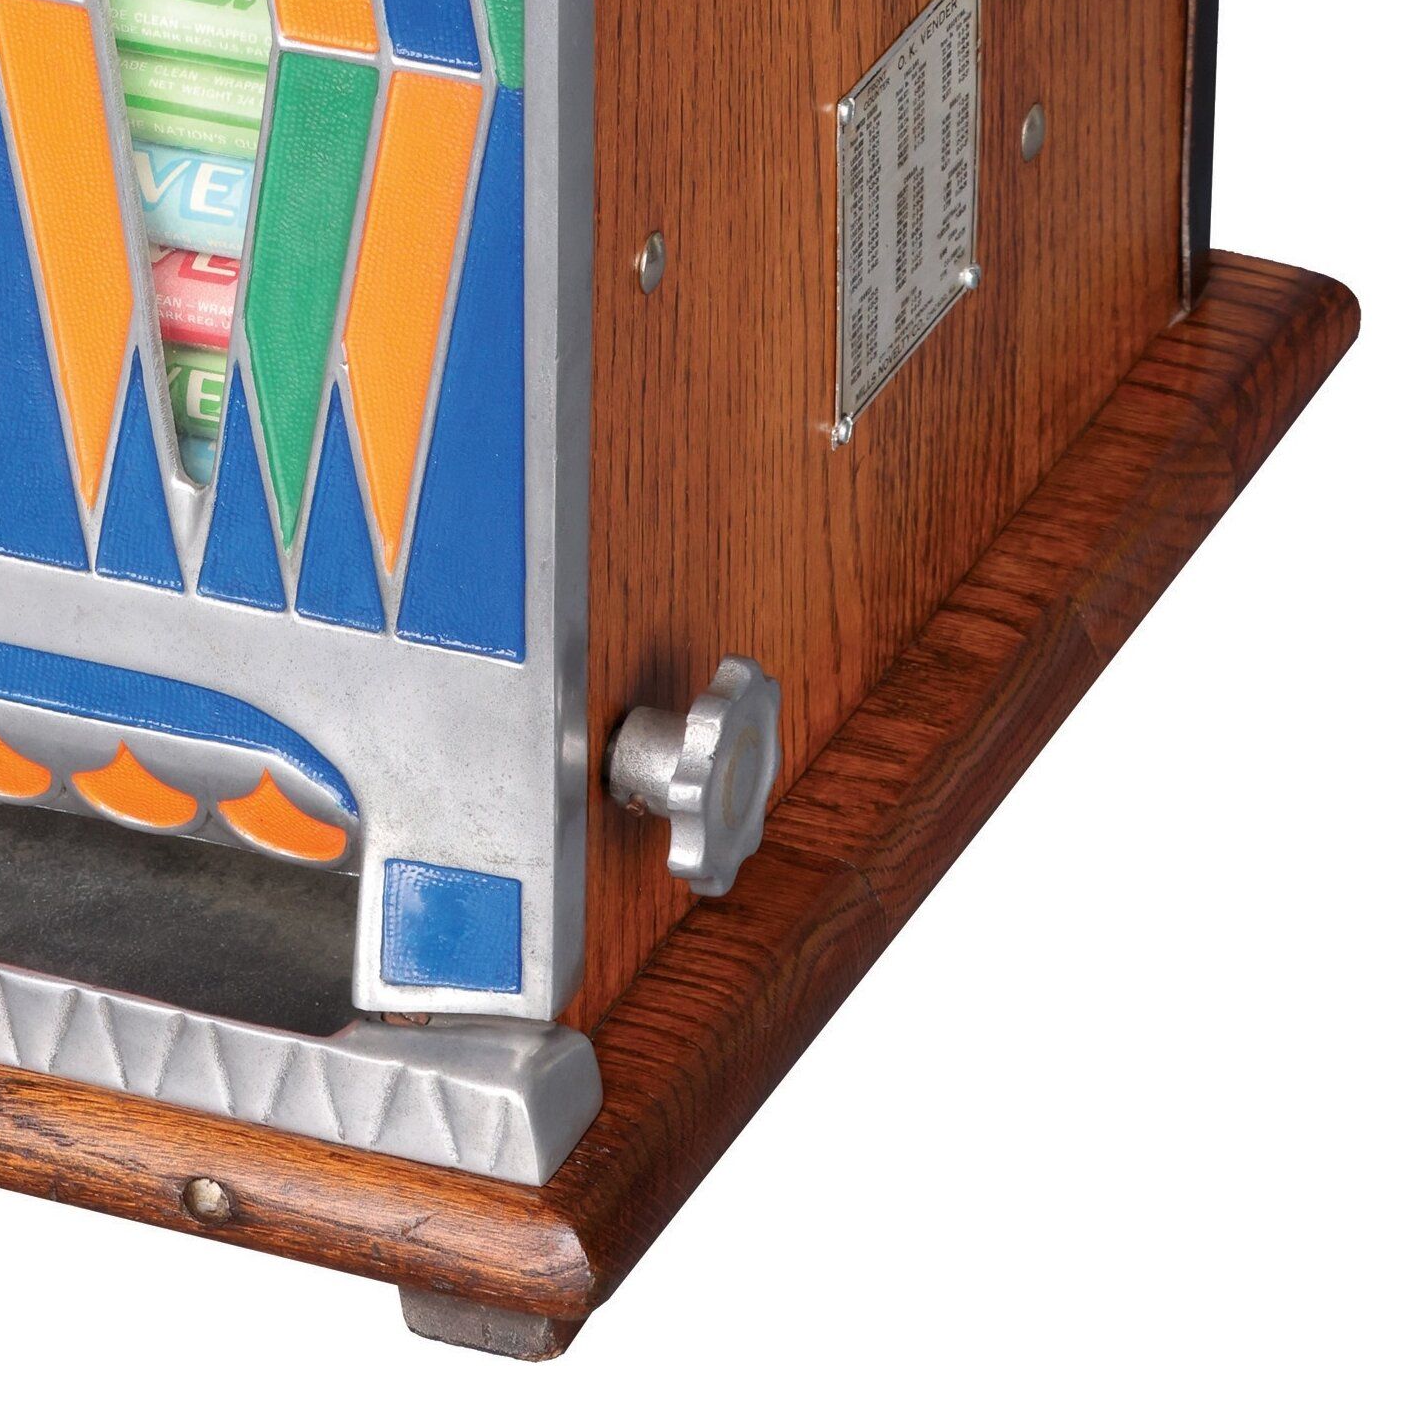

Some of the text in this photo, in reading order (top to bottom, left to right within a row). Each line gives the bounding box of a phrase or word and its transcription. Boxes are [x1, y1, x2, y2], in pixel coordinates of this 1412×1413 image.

[135, 12, 257, 43] CLEAN WRAPPED
[154, 65, 197, 80] CLEAN
[149, 79, 232, 101] NET WEIGHT
[154, 124, 226, 144] NATION'S
